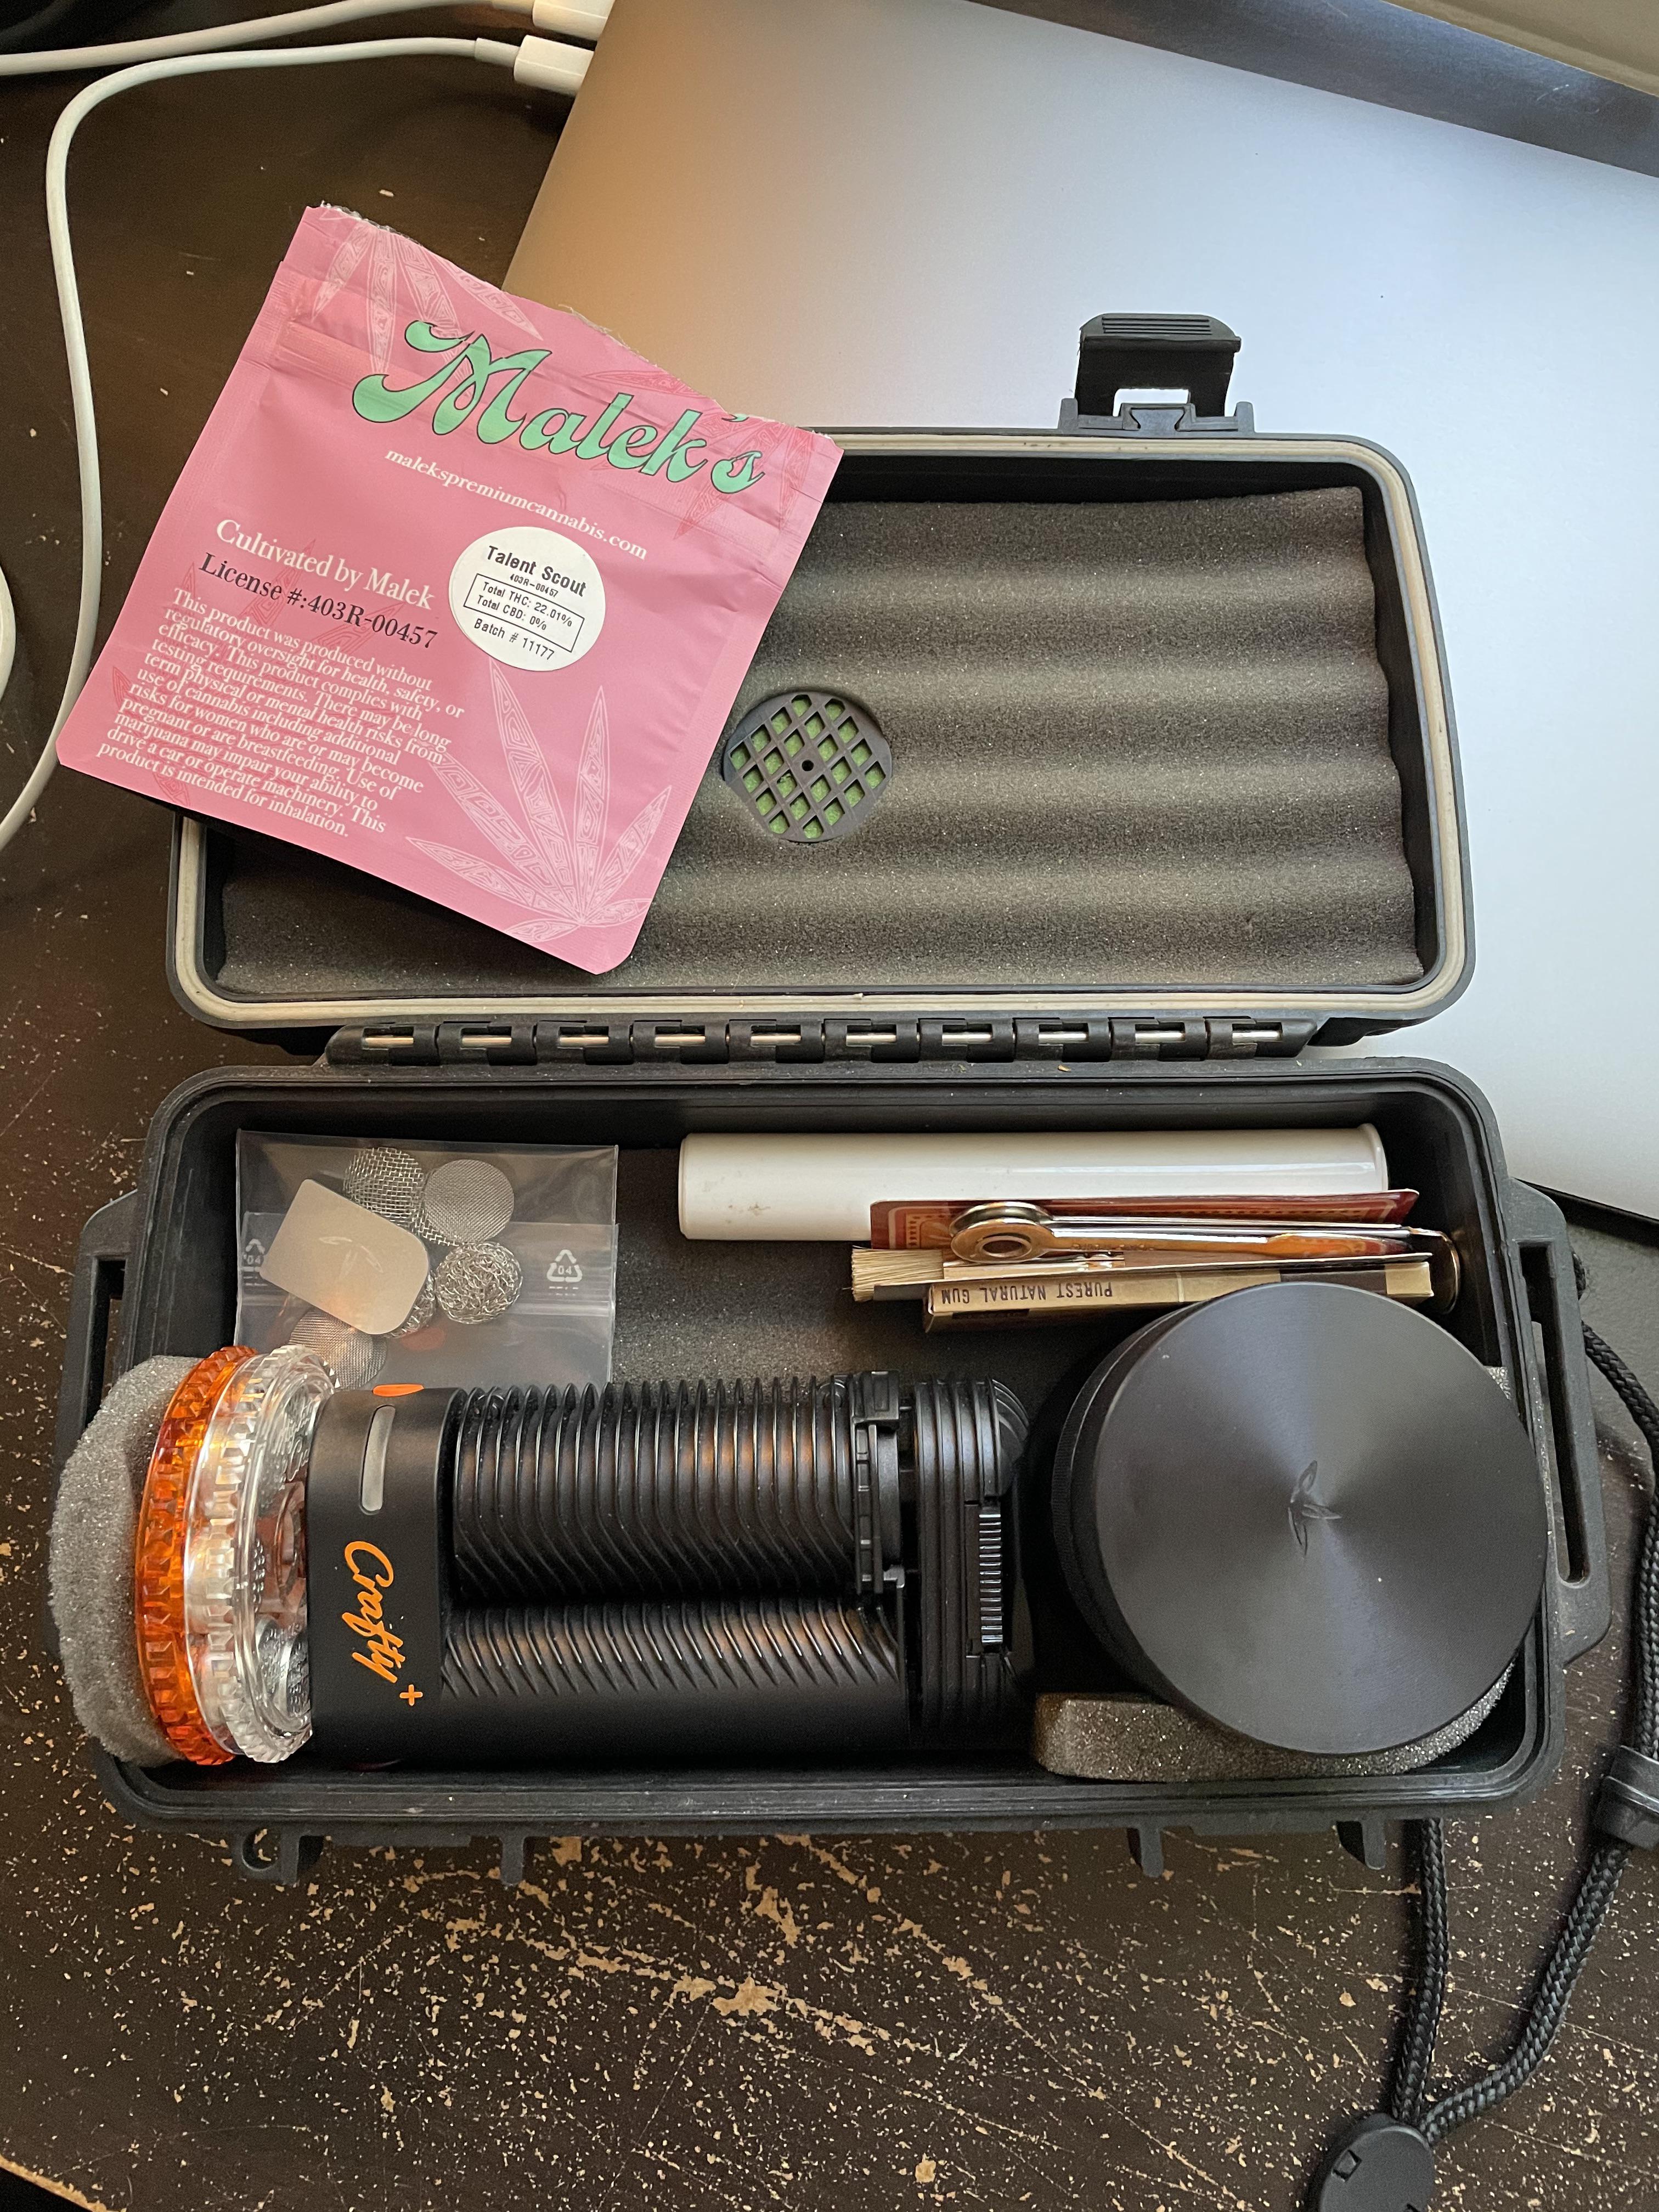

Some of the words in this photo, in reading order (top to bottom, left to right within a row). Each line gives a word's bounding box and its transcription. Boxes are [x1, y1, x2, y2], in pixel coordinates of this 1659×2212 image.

[385, 449, 647, 560] malekspremiumcannabis.com
[199, 552, 283, 600] License
[217, 519, 334, 577] Cultivated
[334, 558, 363, 591] by
[363, 568, 435, 610] Malek
[483, 582, 506, 597] Total
[509, 591, 531, 607] THC:
[534, 602, 572, 627] 22.01%
[487, 545, 537, 575] Talent
[541, 566, 586, 597] Scout
[510, 574, 558, 597] 403R-00457
[174, 588, 207, 614] This
[205, 608, 272, 640] product
[274, 631, 301, 648] was
[300, 641, 375, 672] produced
[376, 664, 433, 691] without
[474, 618, 505, 639] Batch
[509, 632, 518, 642] #
[523, 637, 555, 660] 11177
[477, 595, 500, 610] Total
[503, 605, 526, 621] CBD:
[529, 616, 547, 630] 0%
[145, 654, 182, 675] term
[179, 669, 247, 699] physical
[246, 691, 264, 703] or
[264, 697, 317, 721] mental
[317, 709, 363, 736] health
[366, 728, 402, 748] risks
[403, 738, 443, 765] from
[152, 639, 207, 672] testing
[208, 662, 307, 703] requirements.
[314, 691, 358, 716] There
[359, 710, 392, 730] may
[392, 715, 411, 733] be
[414, 723, 451, 753] long
[159, 623, 219, 658] efficacy.
[228, 645, 259, 669] This
[259, 662, 320, 687] product
[320, 681, 387, 709] complies
[391, 702, 422, 721] with
[165, 608, 246, 648] regulatory
[247, 641, 316, 670] oversight
[317, 658, 341, 677] for
[341, 667, 390, 695] health,
[393, 686, 441, 712] safety,
[445, 704, 465, 719] or
[115, 713, 189, 747] marijuana
[190, 740, 223, 760] may
[223, 747, 273, 774] impair
[269, 767, 309, 786] your
[310, 776, 359, 806] ability
[360, 796, 377, 811] to
[119, 698, 191, 731] pregnant
[193, 724, 211, 737] or
[211, 730, 236, 745] are
[238, 735, 340, 782] breastfeeding.
[346, 768, 377, 792] Use
[379, 786, 402, 800] of
[128, 683, 167, 704] risks
[168, 695, 193, 714] for
[195, 708, 247, 732] women
[250, 723, 280, 742] who
[281, 736, 307, 750] are
[308, 744, 327, 757] or
[327, 750, 360, 771] may
[362, 756, 424, 793] become
[137, 668, 164, 686] use
[167, 679, 188, 693] of
[185, 687, 250, 716] cannabis
[252, 706, 324, 742] including
[323, 731, 401, 765] additional
[96, 743, 161, 772] product
[160, 761, 173, 777] is
[176, 766, 244, 799] intended
[242, 788, 268, 807] for
[267, 795, 348, 837] inhalation.
[107, 726, 146, 749] drive
[148, 744, 157, 754] a
[159, 747, 184, 763] car
[185, 756, 204, 769] or
[204, 762, 261, 787] operate
[262, 780, 343, 817] machinery.
[350, 805, 386, 833] This
[941, 1289, 970, 1304] GUM
[979, 1284, 1046, 1302] NATURAL
[1057, 1281, 1113, 1298] PUREST
